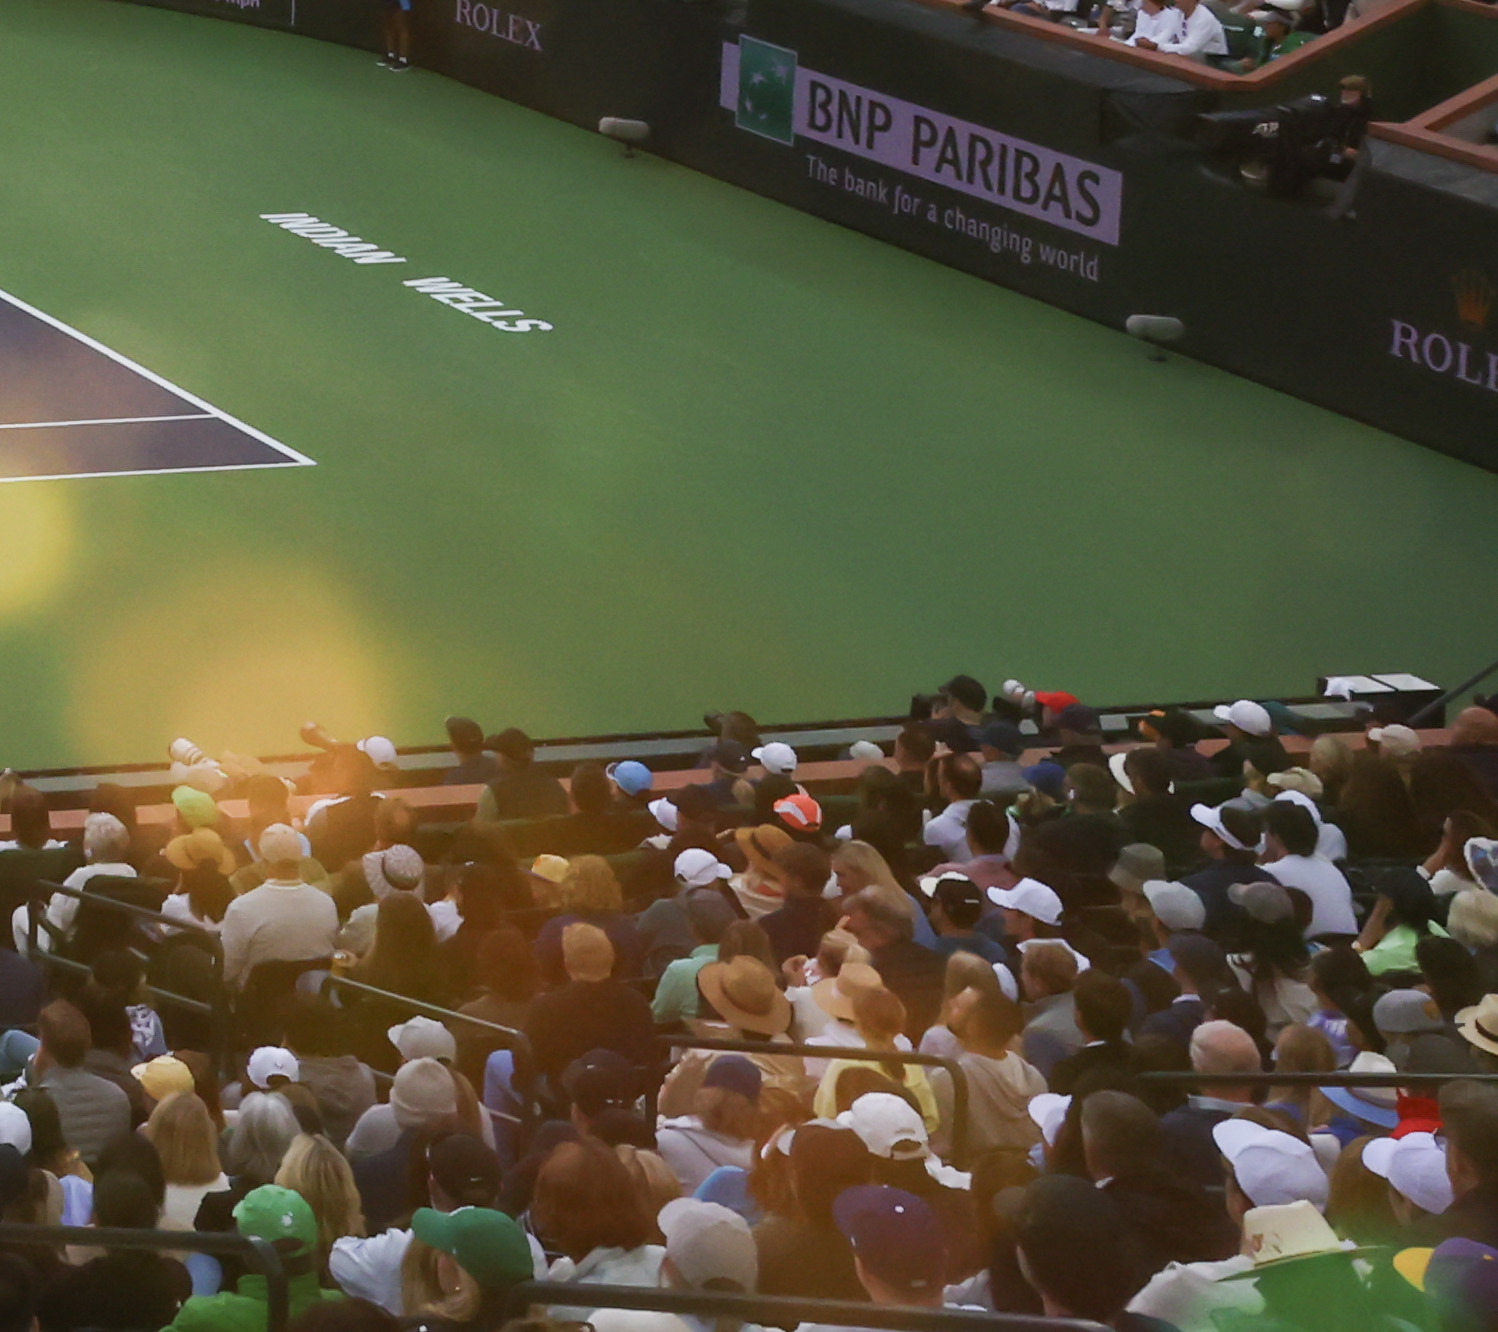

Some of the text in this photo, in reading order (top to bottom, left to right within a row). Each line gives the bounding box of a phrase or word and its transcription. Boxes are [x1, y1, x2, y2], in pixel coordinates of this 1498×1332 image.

[808, 80, 1101, 227] BNP PARIBAS
[259, 212, 554, 332] INDIAN WELLS
[806, 155, 1099, 283] The bank for a changing world
